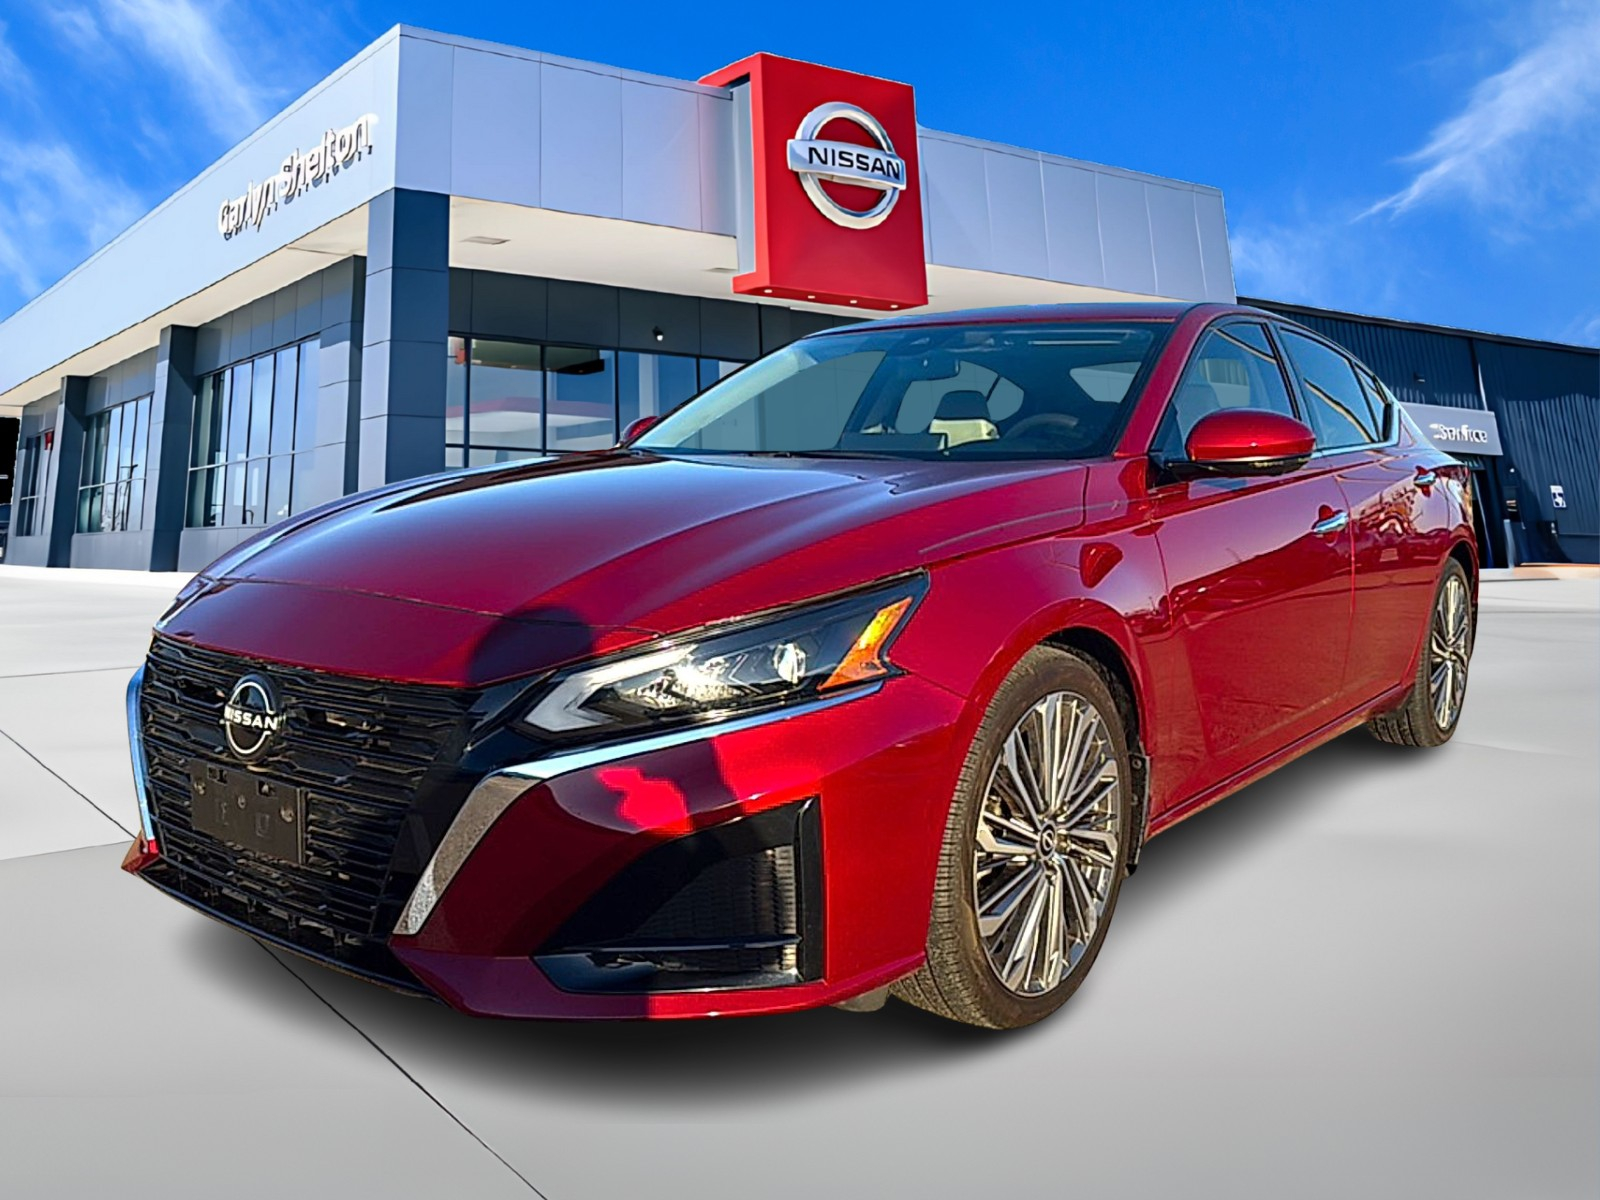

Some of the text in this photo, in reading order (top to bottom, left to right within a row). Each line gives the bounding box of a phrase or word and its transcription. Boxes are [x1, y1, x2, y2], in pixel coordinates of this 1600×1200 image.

[278, 115, 375, 202] Shelton
[808, 146, 900, 180] NISSAN
[224, 705, 278, 730] NISSAN
